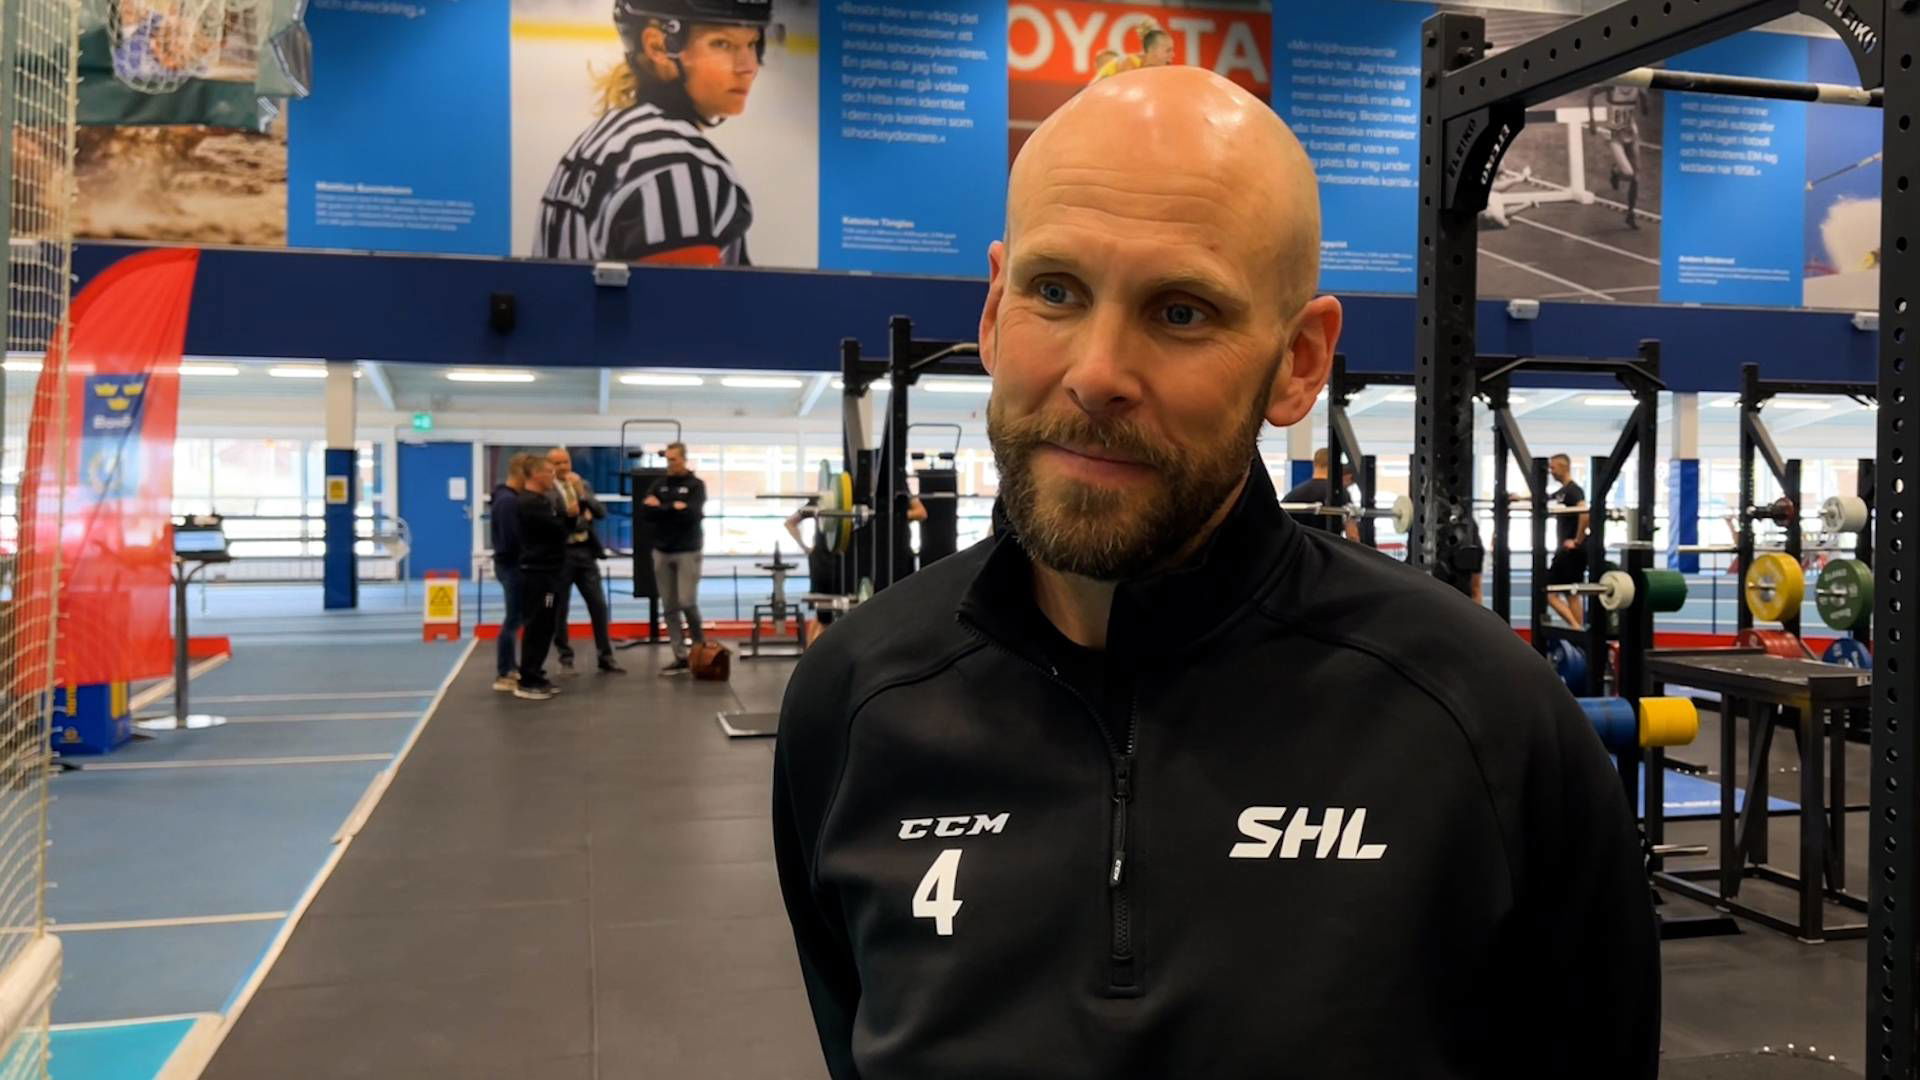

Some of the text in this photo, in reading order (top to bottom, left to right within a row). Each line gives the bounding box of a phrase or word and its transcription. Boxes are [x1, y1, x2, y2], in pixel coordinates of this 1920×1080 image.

[898, 813, 1011, 840] CCM
[1229, 806, 1388, 860] SHL
[912, 849, 963, 936] 4
